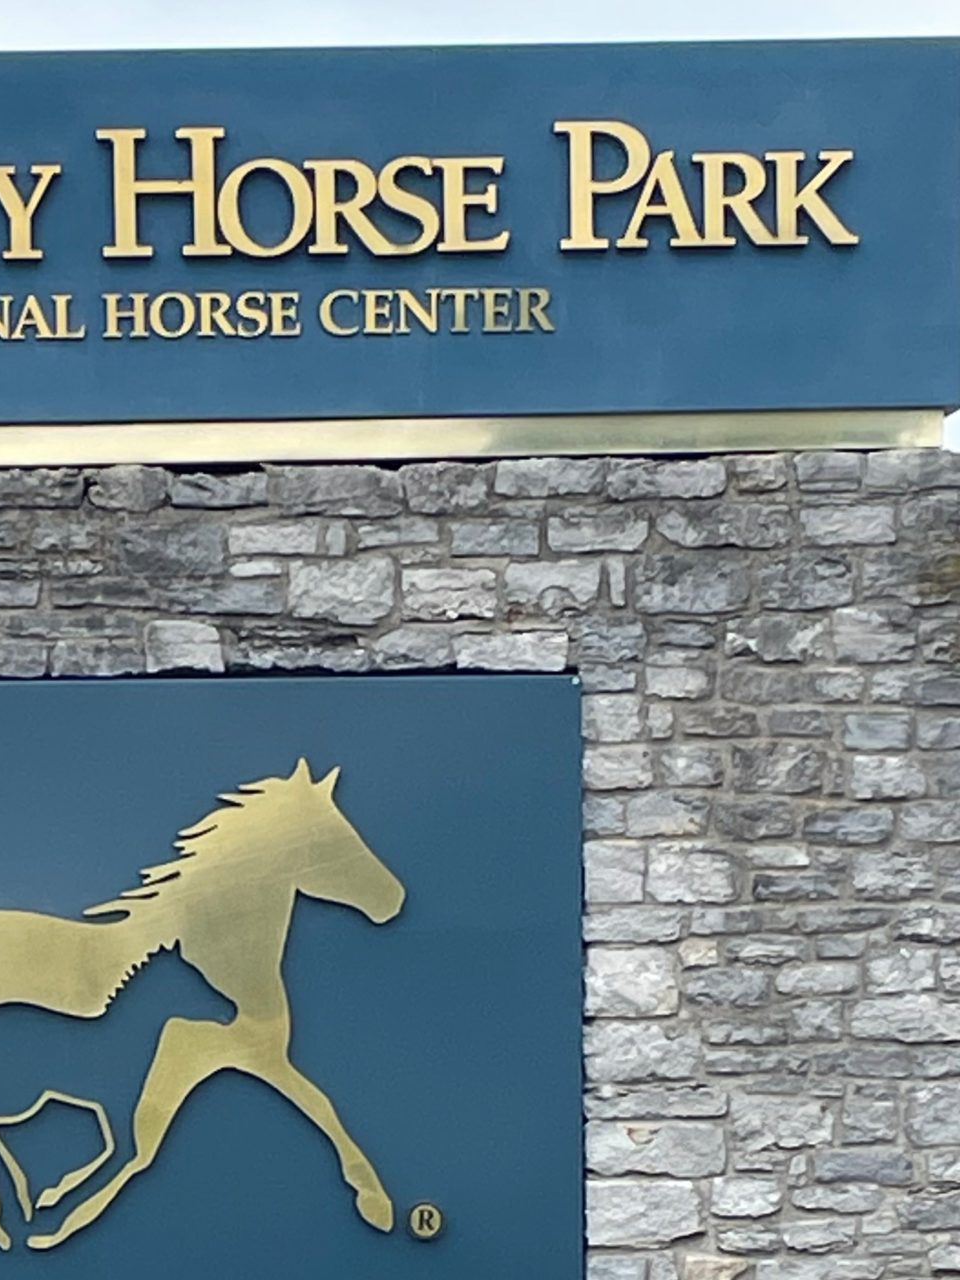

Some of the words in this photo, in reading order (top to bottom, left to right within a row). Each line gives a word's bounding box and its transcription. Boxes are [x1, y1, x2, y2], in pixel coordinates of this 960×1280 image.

[96, 125, 510, 258] HORSE
[554, 119, 859, 250] PARK
[103, 290, 301, 339] HORSE
[320, 287, 555, 334] CENTER
